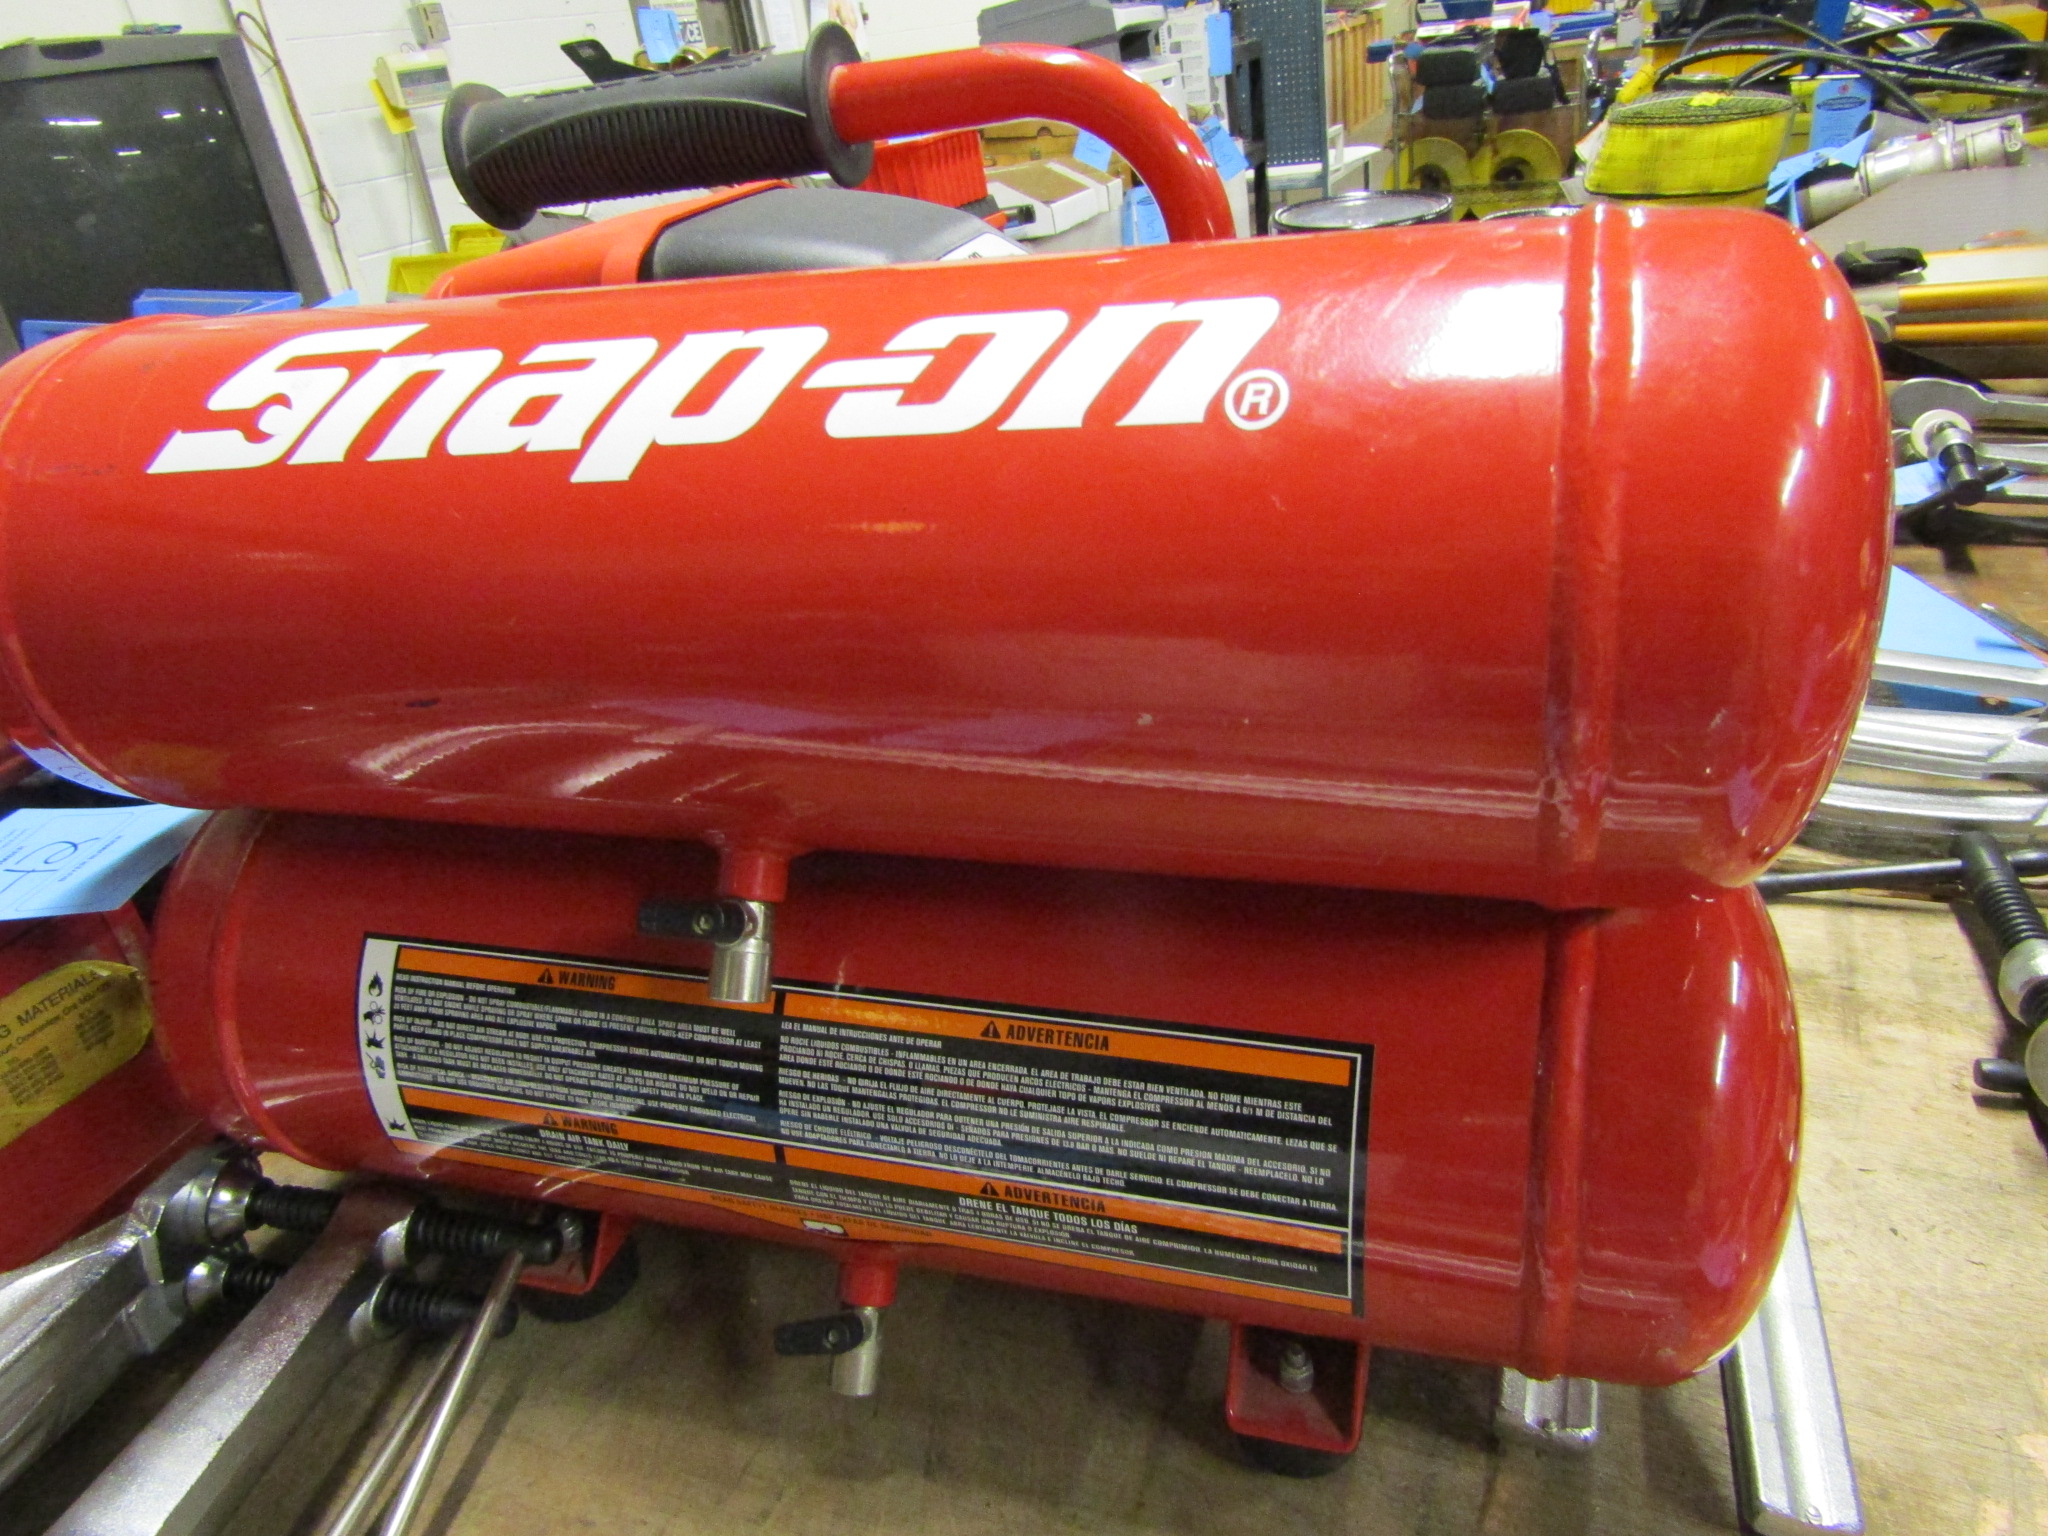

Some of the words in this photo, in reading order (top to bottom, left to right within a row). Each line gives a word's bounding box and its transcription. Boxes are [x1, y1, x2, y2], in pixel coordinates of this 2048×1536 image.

[558, 970, 616, 990] WARNING
[802, 1023, 828, 1034] MANUAL
[828, 1026, 838, 1035] DE
[888, 1034, 904, 1043] ANTE
[905, 1036, 914, 1045] DE
[915, 1037, 942, 1048] OPERAR
[1005, 1023, 1110, 1051] ADVERTENCIA
[840, 1042, 889, 1057] COMBUSTIBLES
[946, 1056, 956, 1065] EN
[957, 1057, 968, 1066] UN
[968, 1059, 986, 1069] AREA
[1040, 1068, 1058, 1078] AREA
[1059, 1070, 1068, 1080] DE
[1070, 1072, 1100, 1084] TRABAJO
[1102, 1076, 1121, 1087] DEBE
[1122, 1079, 1144, 1090] ESTAR
[1146, 1082, 1164, 1092] BIEN
[1207, 1090, 1218, 1100] NO
[1220, 1091, 1241, 1103] FUME
[1242, 1095, 1282, 1108] MIENTRAS
[1283, 1100, 1302, 1111] ESTE
[845, 1052, 866, 1063] CERCA
[966, 1068, 980, 1078] QUE
[1020, 1075, 1043, 1086] ARCOS
[1092, 1085, 1131, 1098] MANTENGA
[1132, 1090, 1142, 1100] EL
[1142, 1091, 1194, 1107] COMPRESSOR
[1195, 1099, 1204, 1108] AL
[1206, 1100, 1234, 1112] MENOS
[1235, 1104, 1240, 1113] A
[1264, 1109, 1274, 1118] DE
[1276, 1110, 1316, 1124] DISTANCIA
[1317, 1116, 1332, 1126] DEL
[965, 1078, 974, 1087] DE
[976, 1079, 1000, 1090] DONDE
[1018, 1085, 1056, 1098] CUALQUIER
[1077, 1093, 1086, 1102] DE
[816, 1081, 828, 1090] LAS
[940, 1098, 949, 1107] EL
[950, 1100, 996, 1114] COMPRESSOR
[998, 1106, 1008, 1115] NO
[1009, 1108, 1018, 1117] LE
[1018, 1109, 1062, 1123] SUMINISTRA
[1062, 1116, 1080, 1126] AIRE
[1080, 1118, 1125, 1132] RESPIRABLE.
[879, 1081, 888, 1089] EL
[888, 1082, 908, 1092] FLUJO
[909, 1085, 918, 1094] DE
[920, 1086, 935, 1096] AIRE
[936, 1088, 986, 1103] DIRECTAMENTE
[986, 1095, 995, 1104] AL
[1066, 1107, 1075, 1115] LA
[1099, 1111, 1108, 1120] EL
[1108, 1112, 1159, 1127] COMPRESSOR
[1160, 1120, 1170, 1129] SE
[1172, 1121, 1209, 1134] ENCIENDE
[1284, 1137, 1308, 1149] LEZAS
[1309, 1141, 1326, 1151] QUE
[1326, 1143, 1338, 1153] SE
[539, 1128, 565, 1140] DRAIN
[567, 1133, 581, 1143] AIR
[582, 1136, 604, 1147] TANK
[606, 1139, 628, 1151] DAILY
[562, 1116, 618, 1135] WARNING
[862, 1101, 886, 1112] AJUSTE
[886, 1105, 894, 1113] EL
[896, 1106, 934, 1119] REGULADOR
[935, 1112, 952, 1122] PARA
[1000, 1121, 1030, 1133] PRESIÓN
[1030, 1126, 1040, 1135] DE
[1042, 1127, 1066, 1138] SALIDA
[1066, 1131, 1102, 1144] SUPERIOR
[1110, 1137, 1119, 1146] LA
[1120, 1139, 1154, 1151] INDICADA
[1156, 1144, 1178, 1154] COMO
[1246, 1157, 1260, 1167] DEL
[1308, 1166, 1318, 1175] SI
[1318, 1167, 1330, 1177] NO
[928, 1128, 965, 1141] SEGURIDAD
[886, 1114, 904, 1124] SOLO
[992, 1129, 1009, 1139] PARA
[1010, 1132, 1049, 1145] PRESIONES
[1050, 1138, 1060, 1146] DE
[1117, 1148, 1128, 1156] NO
[1129, 1149, 1156, 1160] SUELDE
[1158, 1154, 1166, 1162] NI
[1168, 1155, 1195, 1166] REPARE
[1196, 1159, 1206, 1168] EL
[1208, 1161, 1236, 1172] TANQUE
[1301, 1175, 1312, 1184] NO
[1314, 1177, 1324, 1185] LO
[1009, 1154, 1070, 1170] TOMACORRIENTES
[1071, 1163, 1093, 1174] ANTES
[1094, 1167, 1104, 1175] DE
[1105, 1168, 1128, 1179] DARLE
[1165, 1177, 1174, 1186] EL
[1176, 1179, 1226, 1194] COMPRESSOR
[1228, 1187, 1238, 1196] SE
[1240, 1189, 1260, 1199] DEBE
[1260, 1192, 1300, 1205] CONECTAR
[1302, 1198, 1307, 1206] A
[1082, 1173, 1100, 1183] BAJO
[1004, 1184, 1105, 1212] ADVERTENCIA
[958, 1196, 993, 1210] DRENE
[996, 1202, 1008, 1212] EL
[1010, 1205, 1050, 1220] TANQUE
[1052, 1211, 1088, 1226] TODOS
[1090, 1217, 1110, 1229] LOS
[1113, 1219, 1138, 1234] DÍAS
